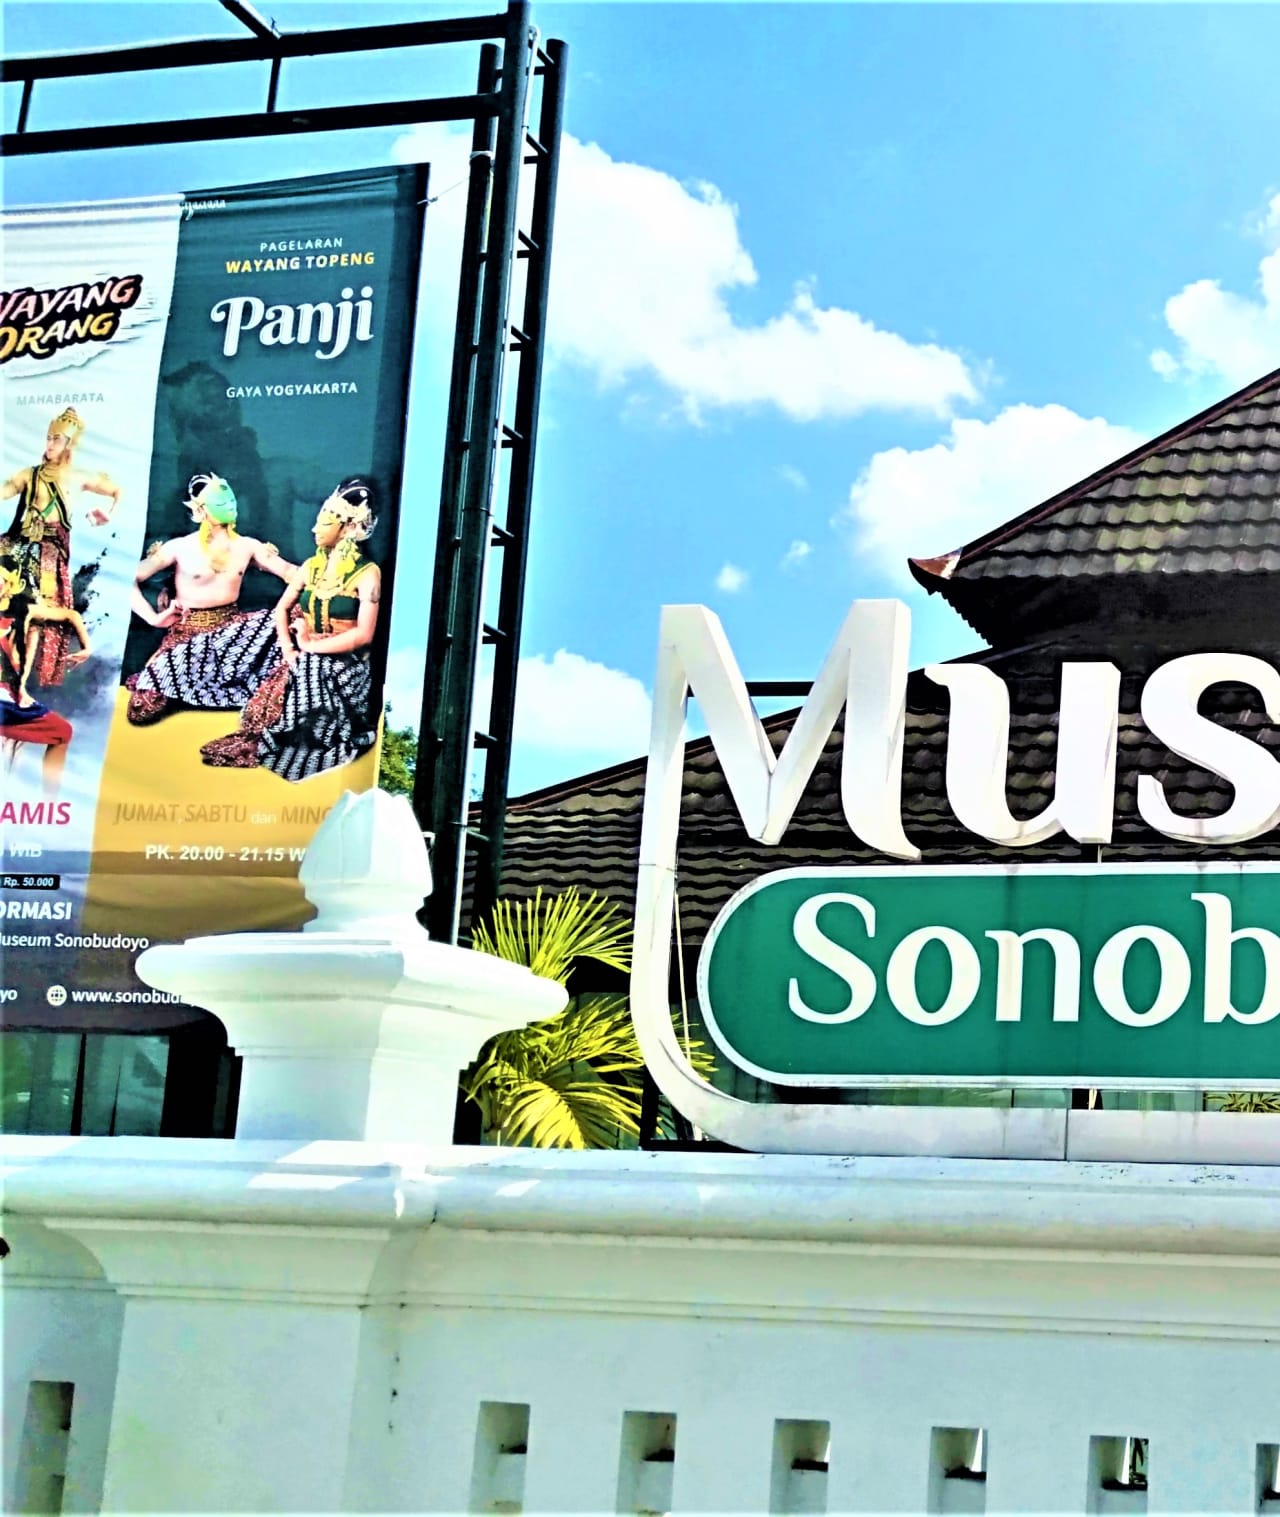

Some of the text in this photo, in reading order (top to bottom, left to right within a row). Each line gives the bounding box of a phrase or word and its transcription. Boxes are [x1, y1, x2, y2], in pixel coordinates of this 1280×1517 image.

[260, 237, 343, 252] PAGELARAN
[226, 252, 375, 274] WAYANG TOPENG
[210, 286, 374, 359] Panji
[226, 382, 358, 398] GAYA YOGYAKARTA
[16, 393, 105, 406] MAHABARATA
[184, 803, 247, 824] SABTU
[251, 813, 276, 825] dan
[145, 845, 174, 860] PK.
[179, 846, 224, 861] 20.00
[239, 847, 284, 862] 21.15
[3, 876, 54, 888] Rp. 50.000
[0, 932, 149, 952] useum Sonobudoyo
[72, 990, 182, 1004] www.sonobud
